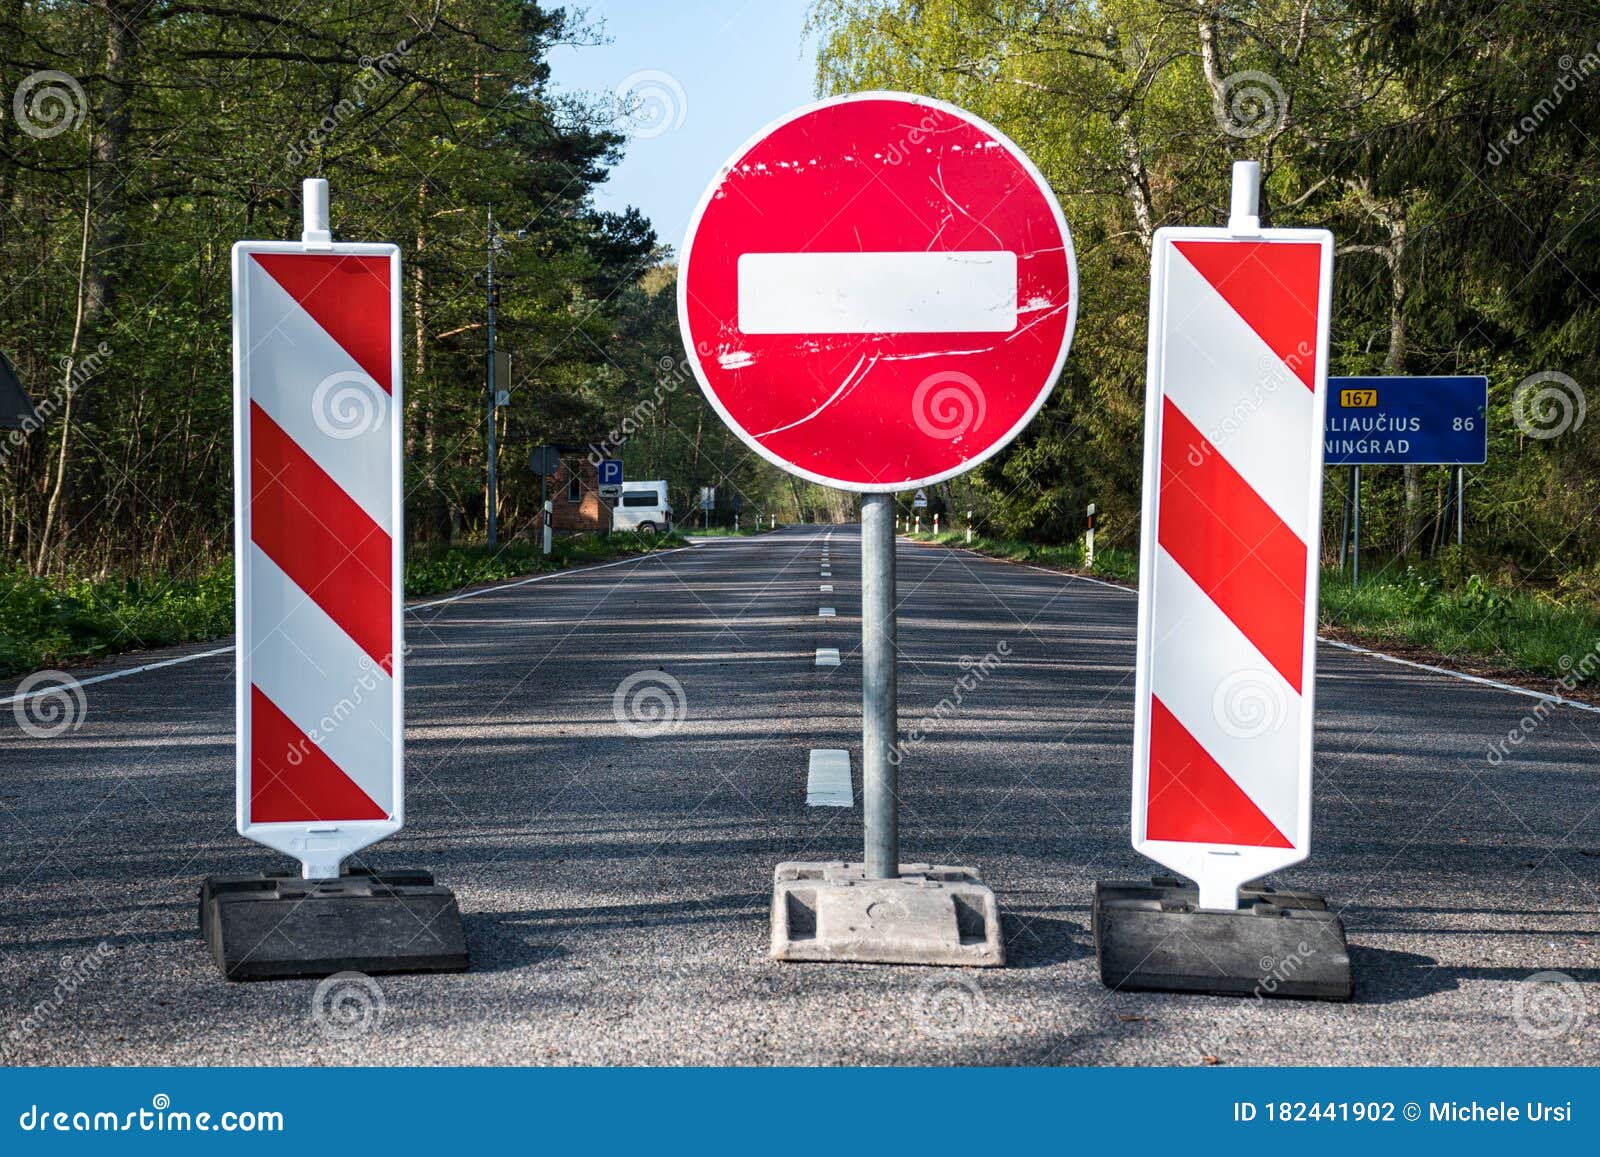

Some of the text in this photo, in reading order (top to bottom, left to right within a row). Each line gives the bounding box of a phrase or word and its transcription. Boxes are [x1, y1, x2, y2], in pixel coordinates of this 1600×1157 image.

[1345, 391, 1373, 406] 167
[1452, 417, 1475, 432] 86
[605, 463, 619, 483] P
